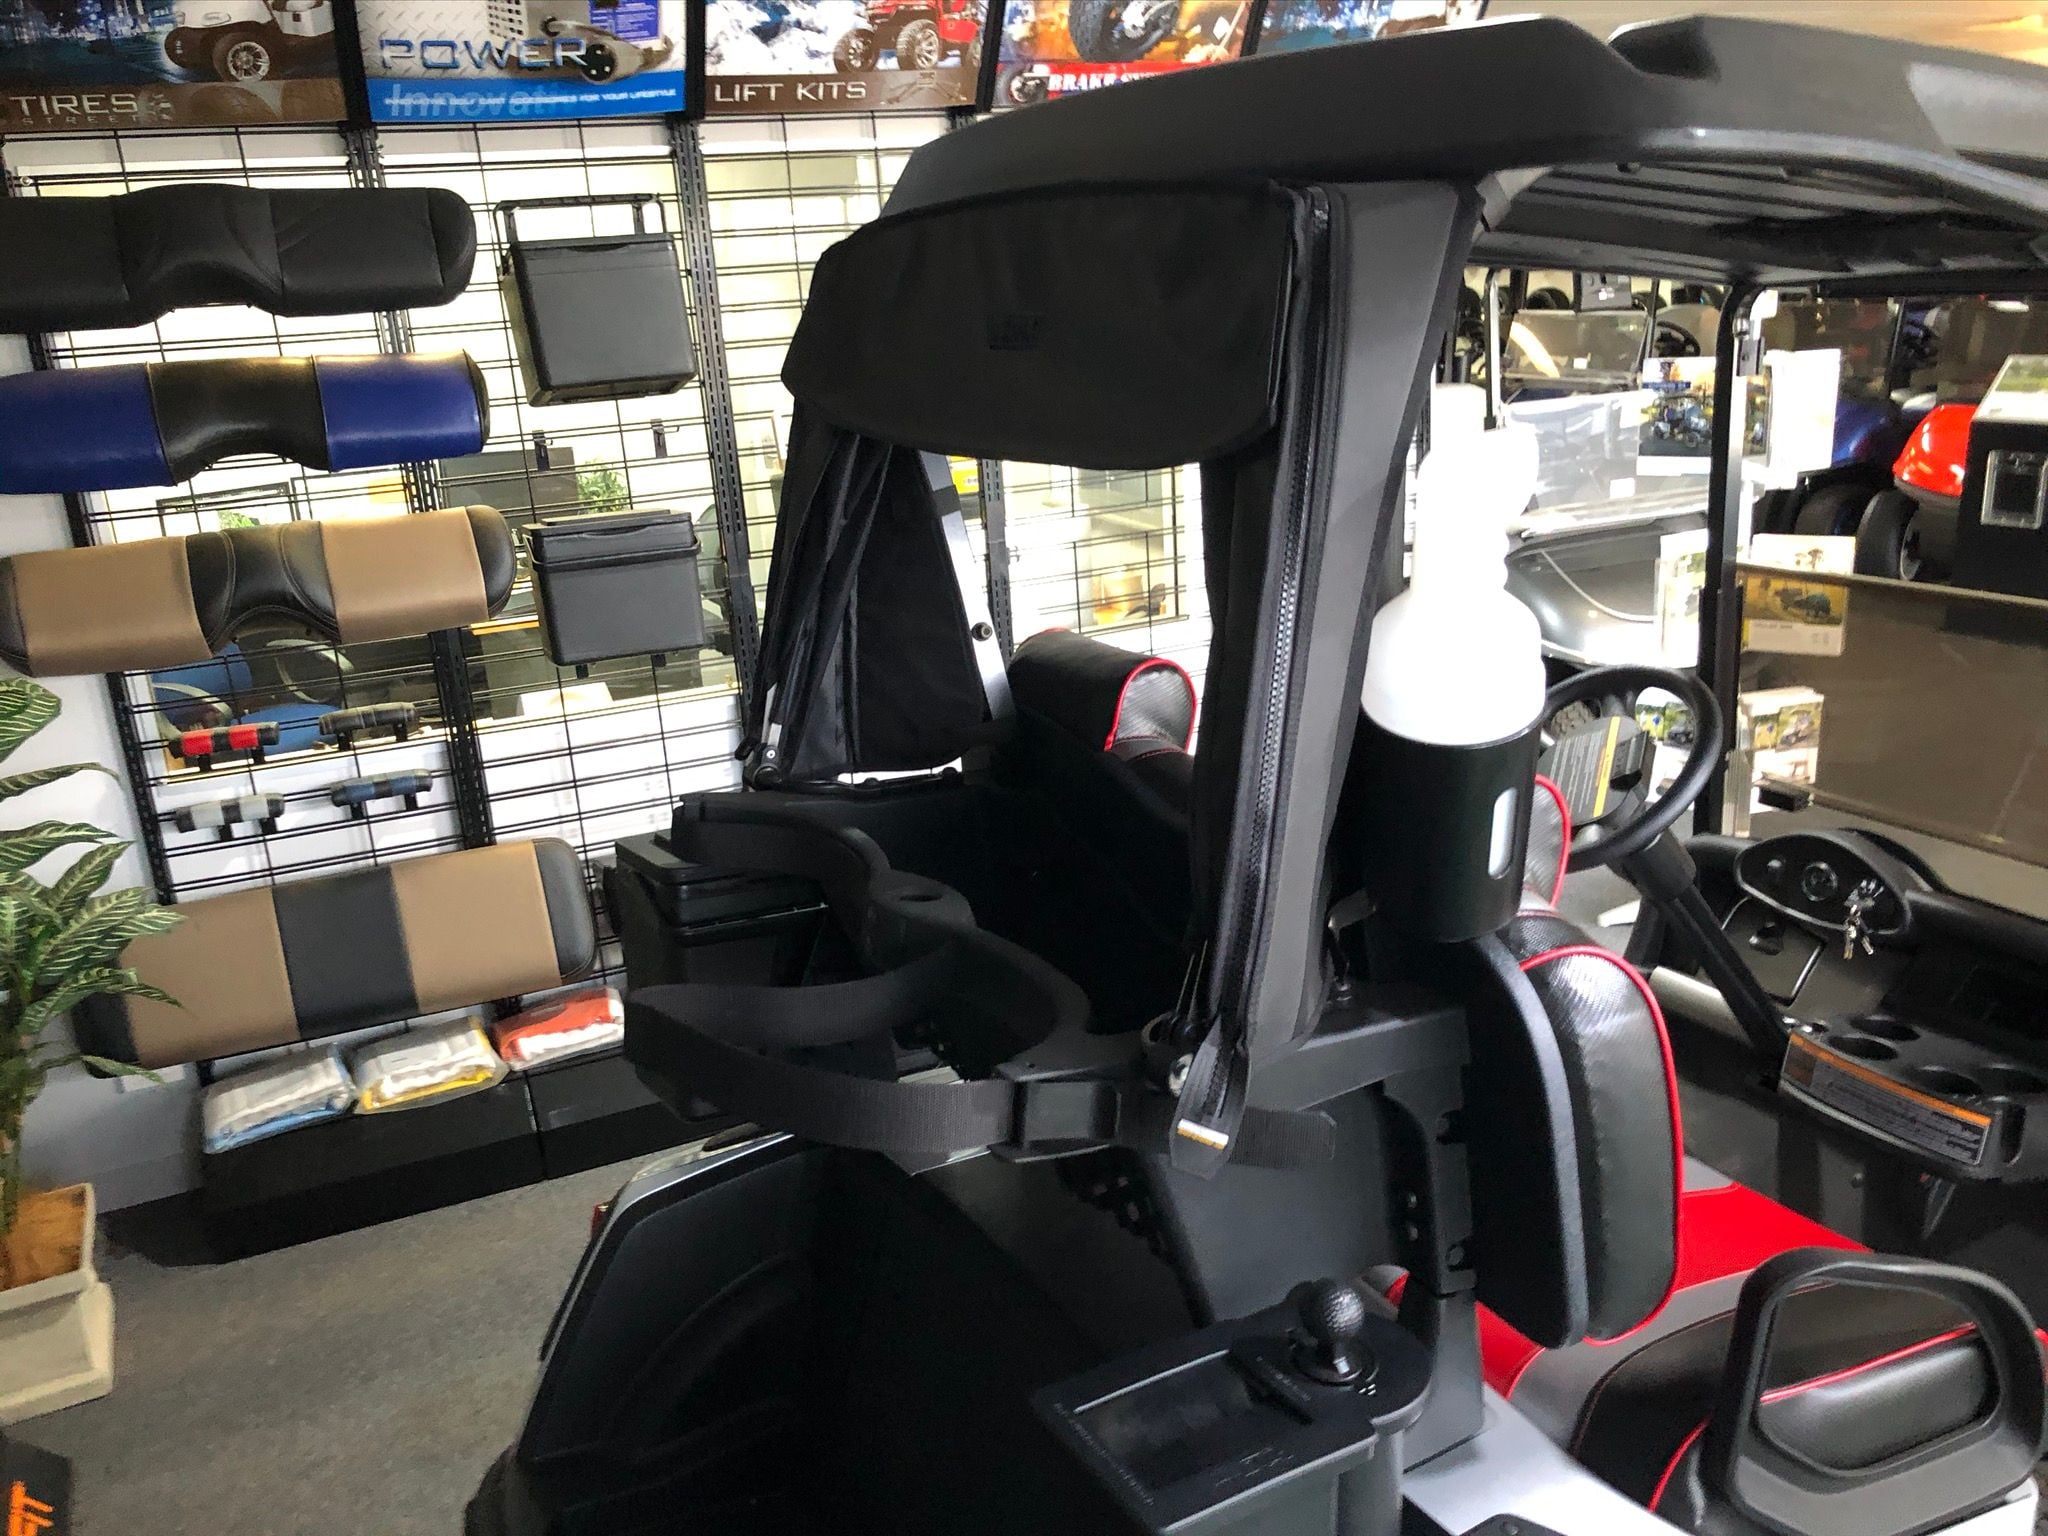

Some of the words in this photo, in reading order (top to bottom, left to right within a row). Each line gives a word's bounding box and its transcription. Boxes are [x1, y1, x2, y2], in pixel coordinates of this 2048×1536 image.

[379, 36, 589, 69] POWER
[602, 91, 629, 101] YOUR
[714, 83, 785, 102] LIFT
[796, 81, 867, 101] KITS
[9, 93, 139, 116] TIRES
[22, 115, 138, 126] STREET
